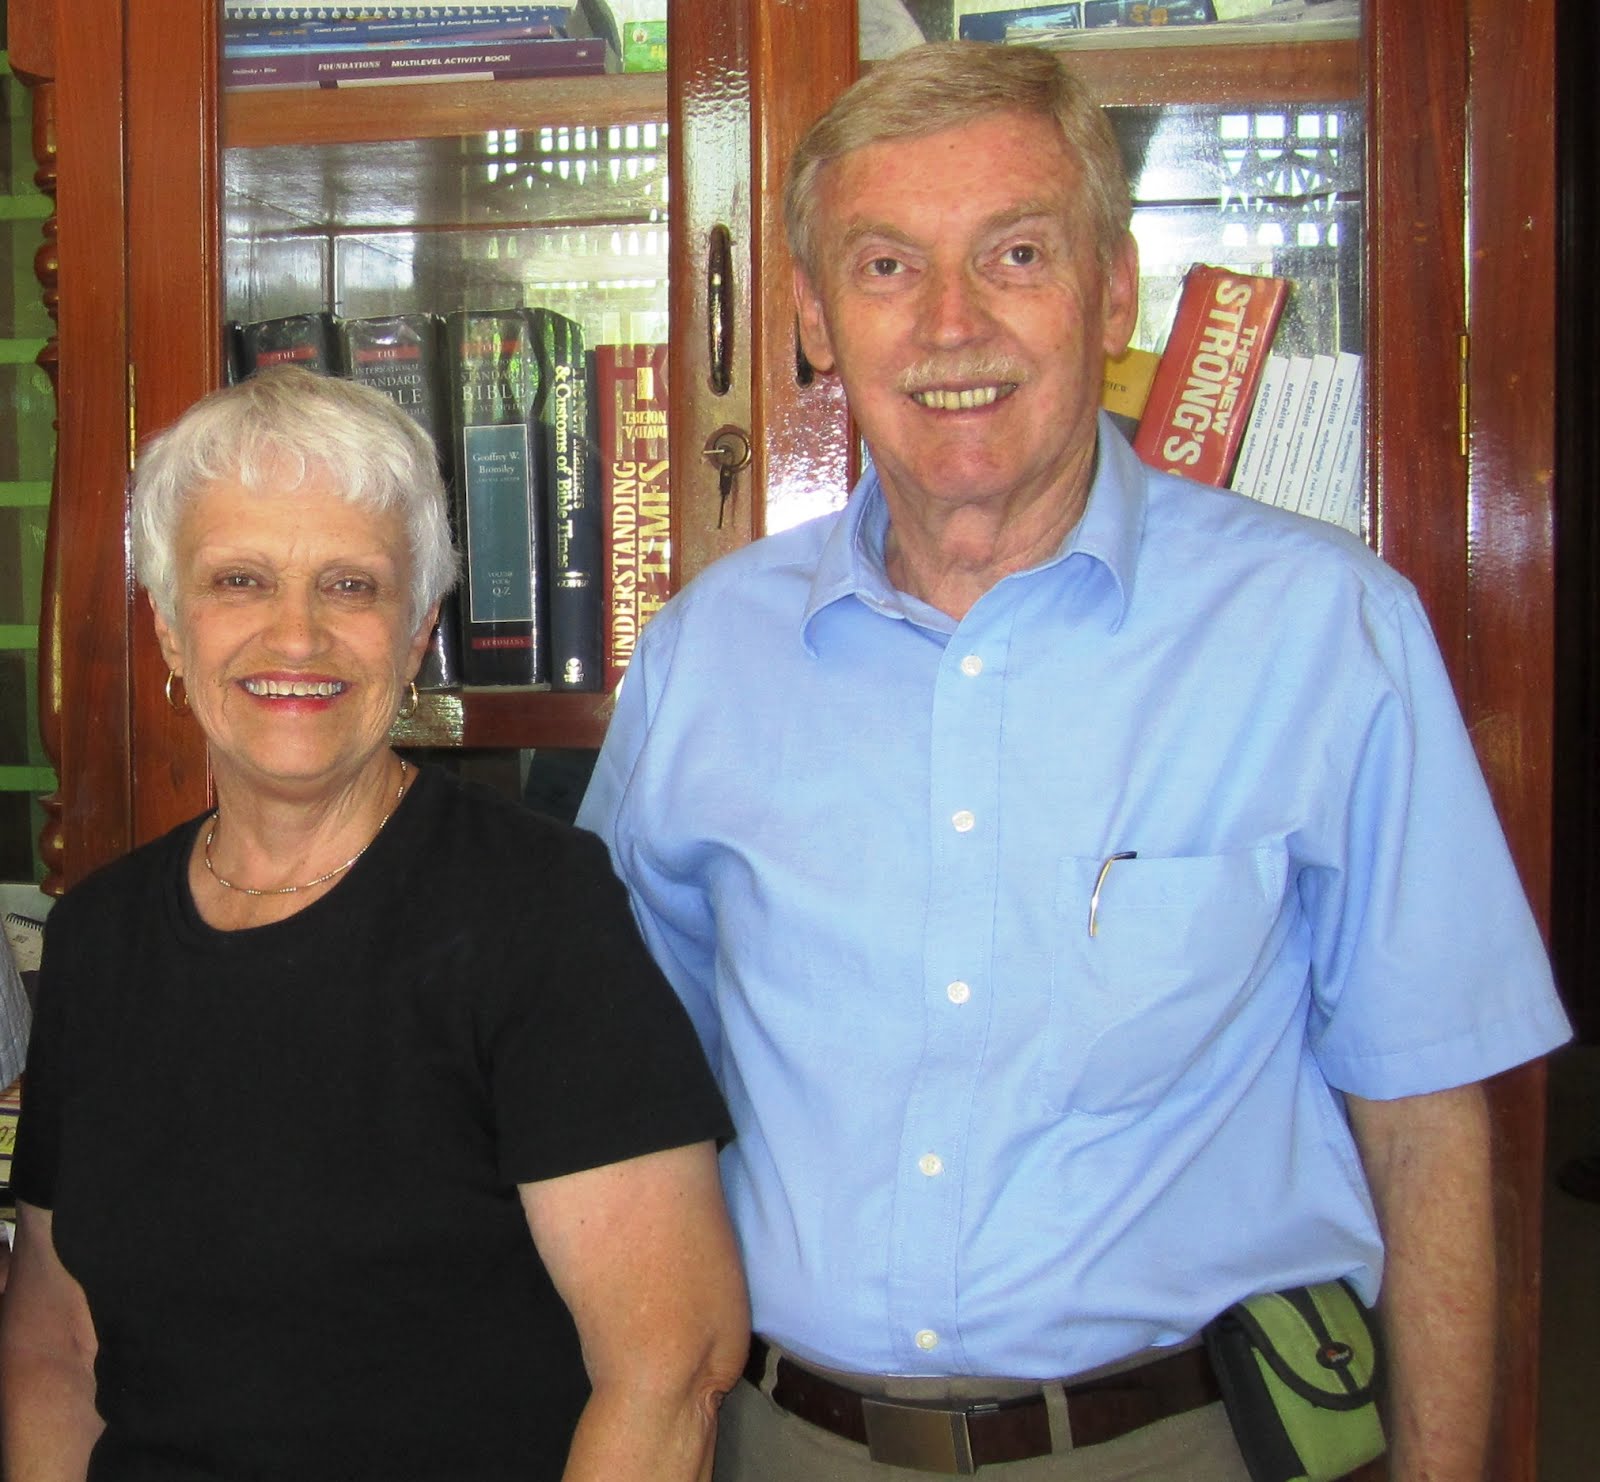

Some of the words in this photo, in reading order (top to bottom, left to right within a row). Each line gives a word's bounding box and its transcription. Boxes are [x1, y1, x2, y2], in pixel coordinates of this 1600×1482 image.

[318, 61, 381, 71] FOUNDATIONS
[391, 58, 442, 68] MULTILEVEL
[444, 56, 483, 65] ACTIVITY
[484, 54, 512, 62] BOOK
[1232, 325, 1258, 374] THE
[462, 382, 526, 401] BIBLE
[556, 365, 571, 383] &
[1163, 280, 1252, 466] STRONG'S
[556, 383, 572, 454] Customs
[1212, 376, 1243, 436] NEW
[556, 455, 573, 476] of
[556, 478, 573, 518] Bible
[558, 520, 574, 568] Times
[612, 460, 637, 667] UNDERSTANDING
